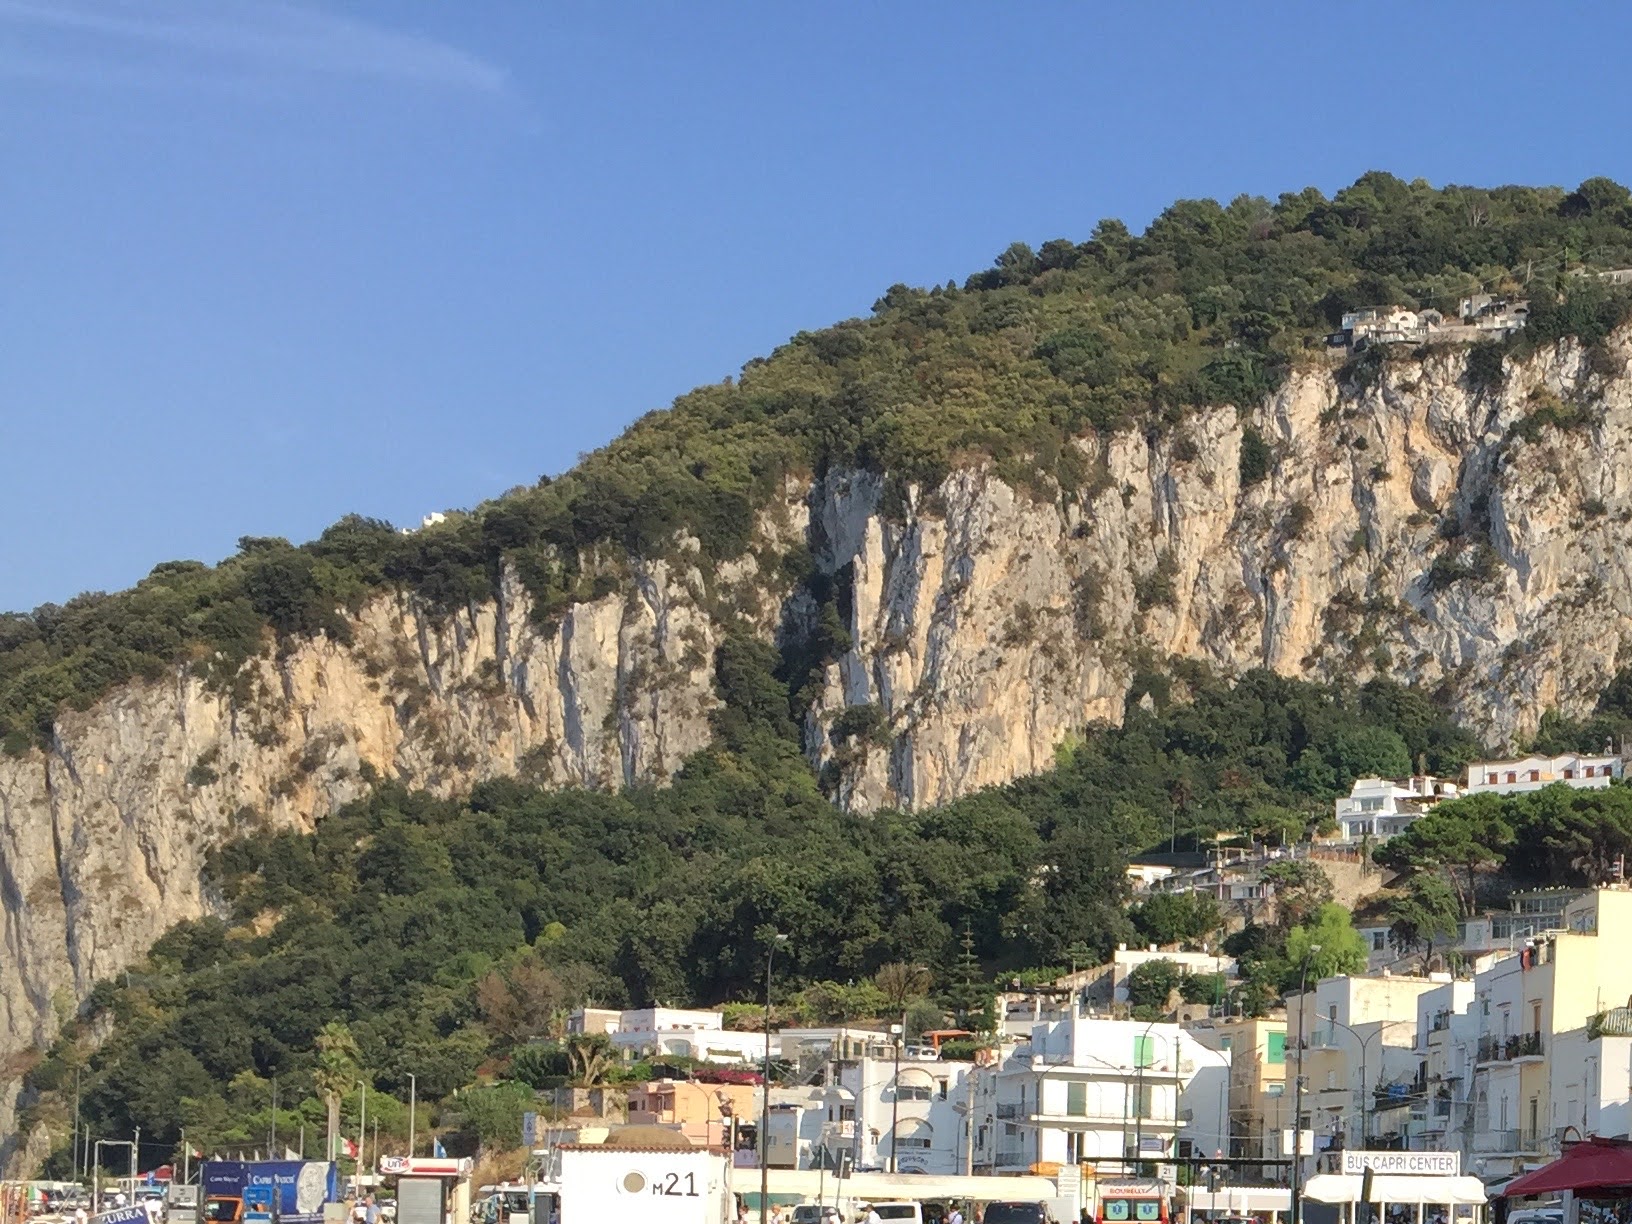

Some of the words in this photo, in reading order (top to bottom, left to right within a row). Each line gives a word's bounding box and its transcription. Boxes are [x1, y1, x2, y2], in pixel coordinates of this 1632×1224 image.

[1347, 1155, 1369, 1169] BUS
[1373, 1156, 1407, 1170] CAPRI
[1409, 1157, 1454, 1171] CENTER
[1163, 1167, 1172, 1175] 21
